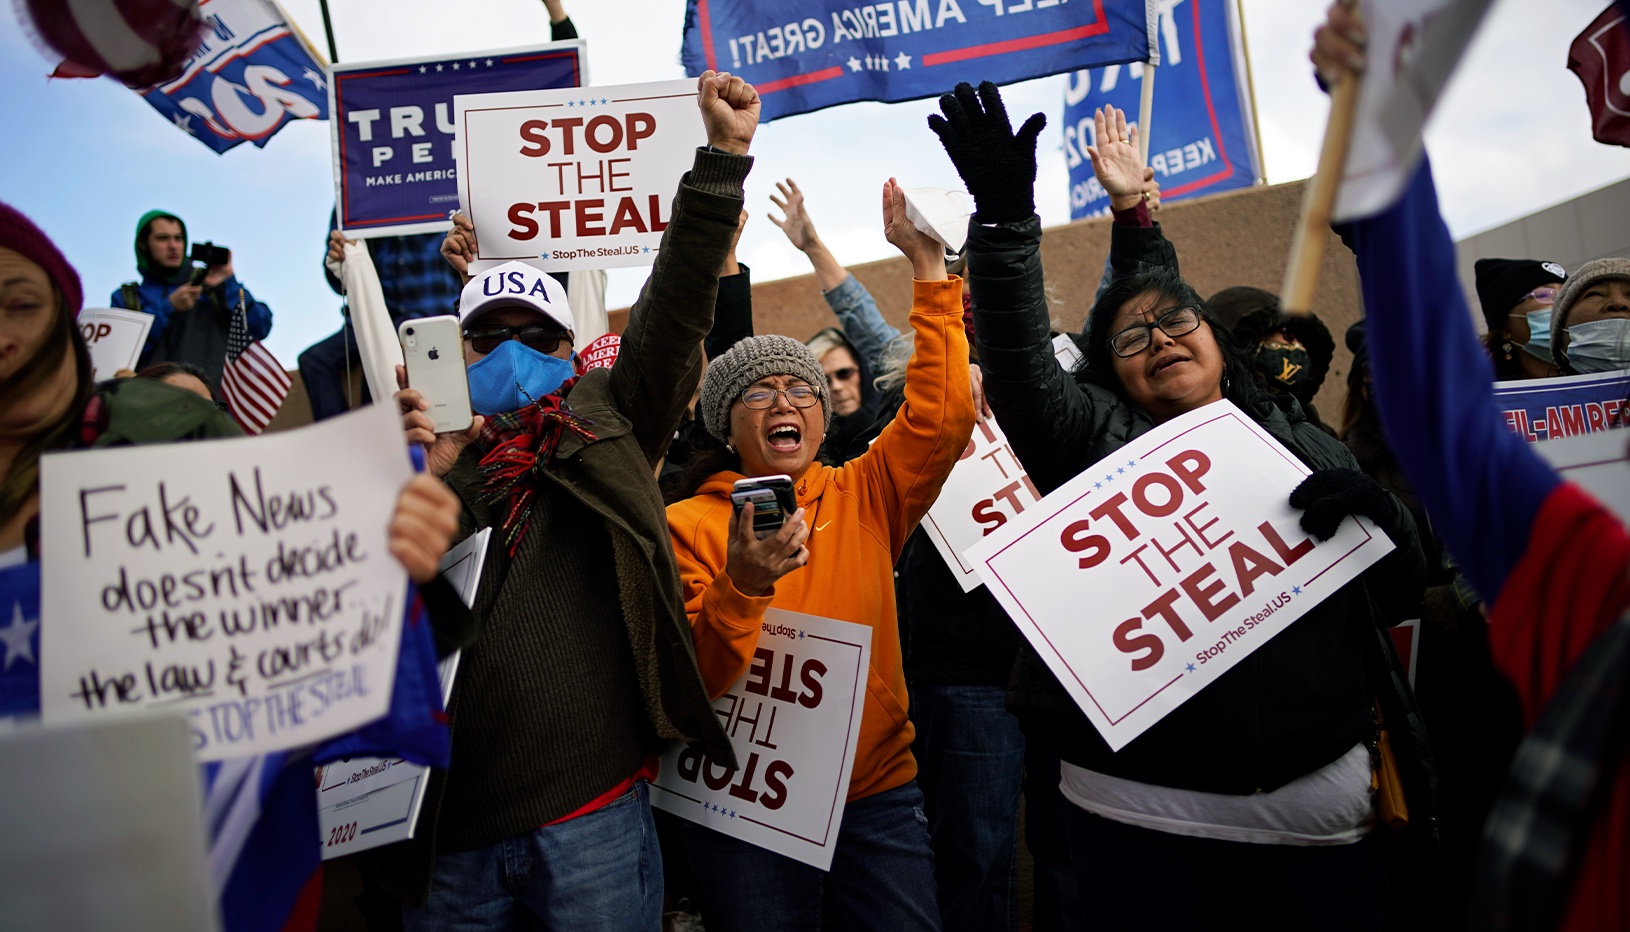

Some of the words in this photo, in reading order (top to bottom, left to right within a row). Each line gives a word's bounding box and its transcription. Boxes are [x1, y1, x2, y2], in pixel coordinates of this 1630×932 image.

[519, 112, 657, 158] STOP
[366, 173, 402, 187] MAKE
[406, 168, 458, 184] AMERIC
[547, 158, 633, 195] THE
[507, 194, 670, 241] STEAL
[483, 271, 551, 304] USA
[81, 323, 112, 343] OP
[79, 481, 215, 558] Fake
[229, 466, 338, 535] News
[1060, 449, 1212, 569] STOP
[266, 528, 368, 584] decide
[1119, 500, 1235, 588] THE
[1112, 520, 1316, 672] STEAL
[130, 610, 215, 649] the
[1196, 591, 1291, 665] StopTheSteal.US
[69, 670, 143, 710] the
[145, 658, 214, 699] law
[226, 645, 247, 697] &
[257, 629, 345, 681] courts
[715, 693, 777, 750] THE
[677, 747, 795, 810] STOP
[327, 820, 357, 847] 2020
